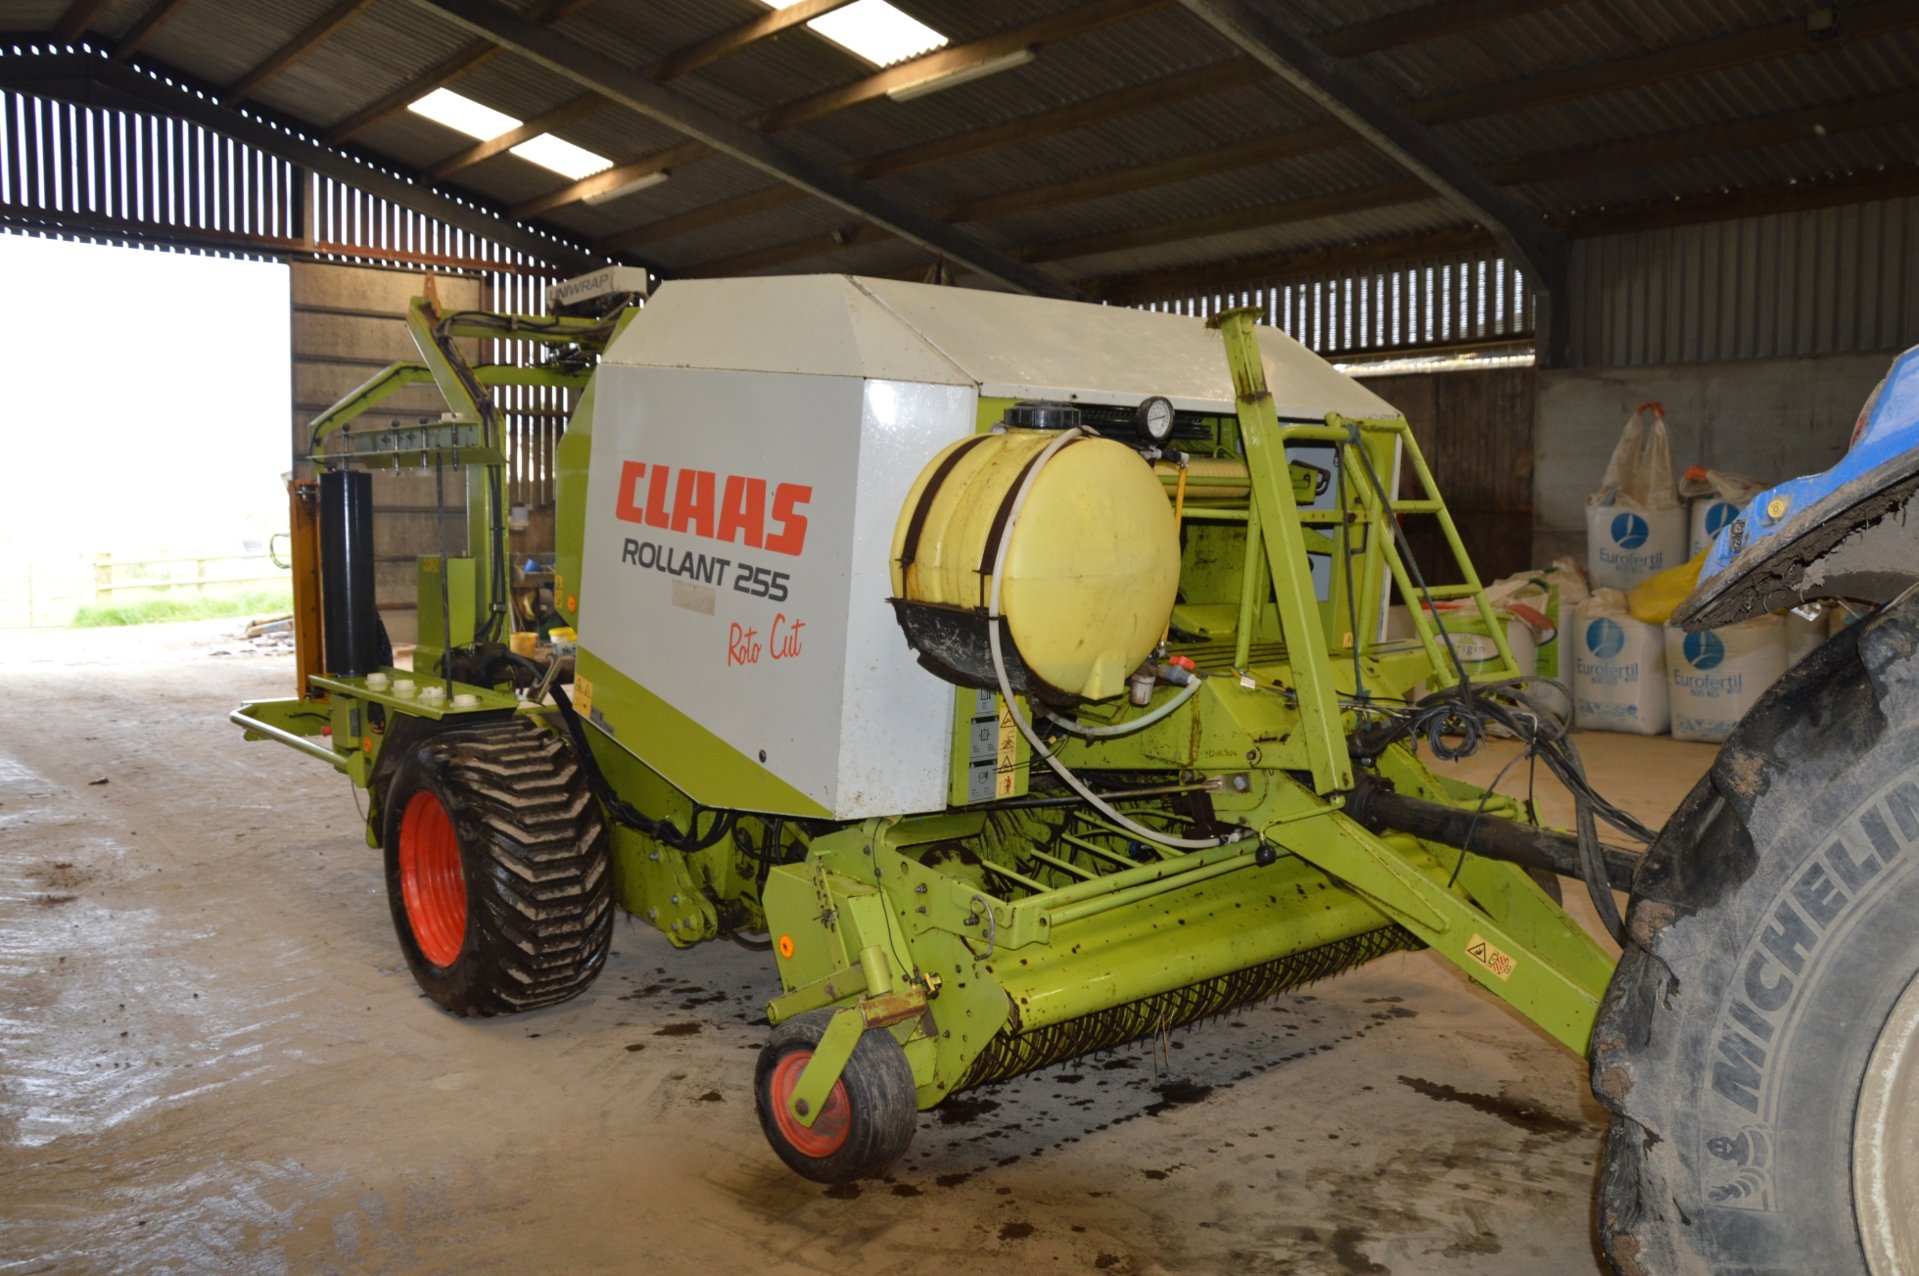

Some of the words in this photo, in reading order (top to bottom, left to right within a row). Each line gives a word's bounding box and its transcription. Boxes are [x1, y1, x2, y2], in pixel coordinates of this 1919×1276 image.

[550, 274, 608, 301] UNIWRAP
[616, 460, 813, 557] CLAAS
[1600, 547, 1663, 566] Eurofertil
[621, 537, 731, 586] ROLLANT
[733, 562, 791, 602] 255
[728, 622, 762, 667] Roto
[769, 613, 805, 659] Cut
[1453, 643, 1485, 655] rigin
[1577, 658, 1638, 677] Eurofertil
[1674, 669, 1742, 690] Eurofertil
